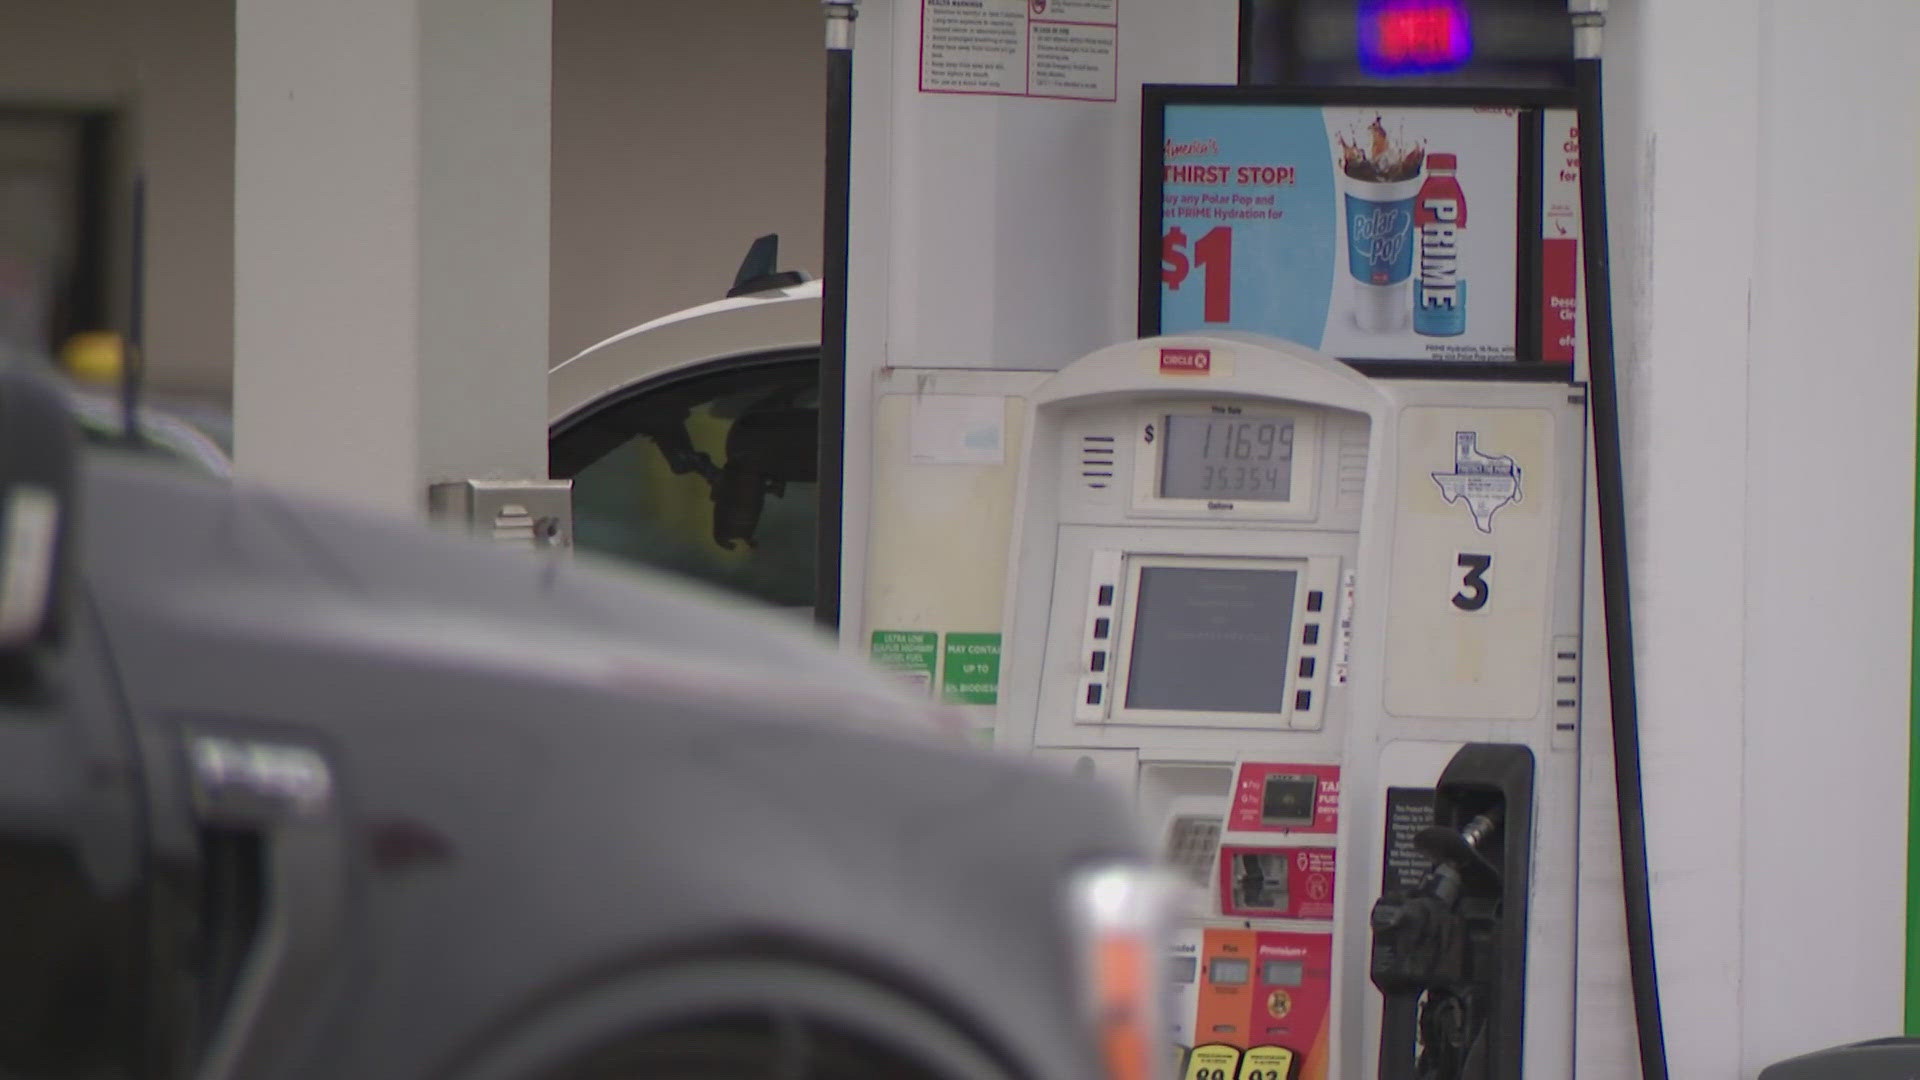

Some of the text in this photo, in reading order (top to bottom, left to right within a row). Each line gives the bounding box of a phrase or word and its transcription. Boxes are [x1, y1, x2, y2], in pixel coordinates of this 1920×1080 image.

[1237, 166, 1295, 185] STOP!
[1164, 193, 1275, 206] uy any Polar Pop and
[1164, 207, 1283, 221] et PRIME Hydration for
[1352, 207, 1399, 241] Polar
[1369, 232, 1404, 266] Pop
[1421, 199, 1458, 310] PRIME
[1162, 226, 1232, 323] $1
[1163, 356, 1193, 366] CIRCLE
[1144, 424, 1154, 445] $
[1451, 553, 1491, 612] 3
[948, 644, 1000, 655] MAY CONTA
[962, 664, 989, 674] UP TO
